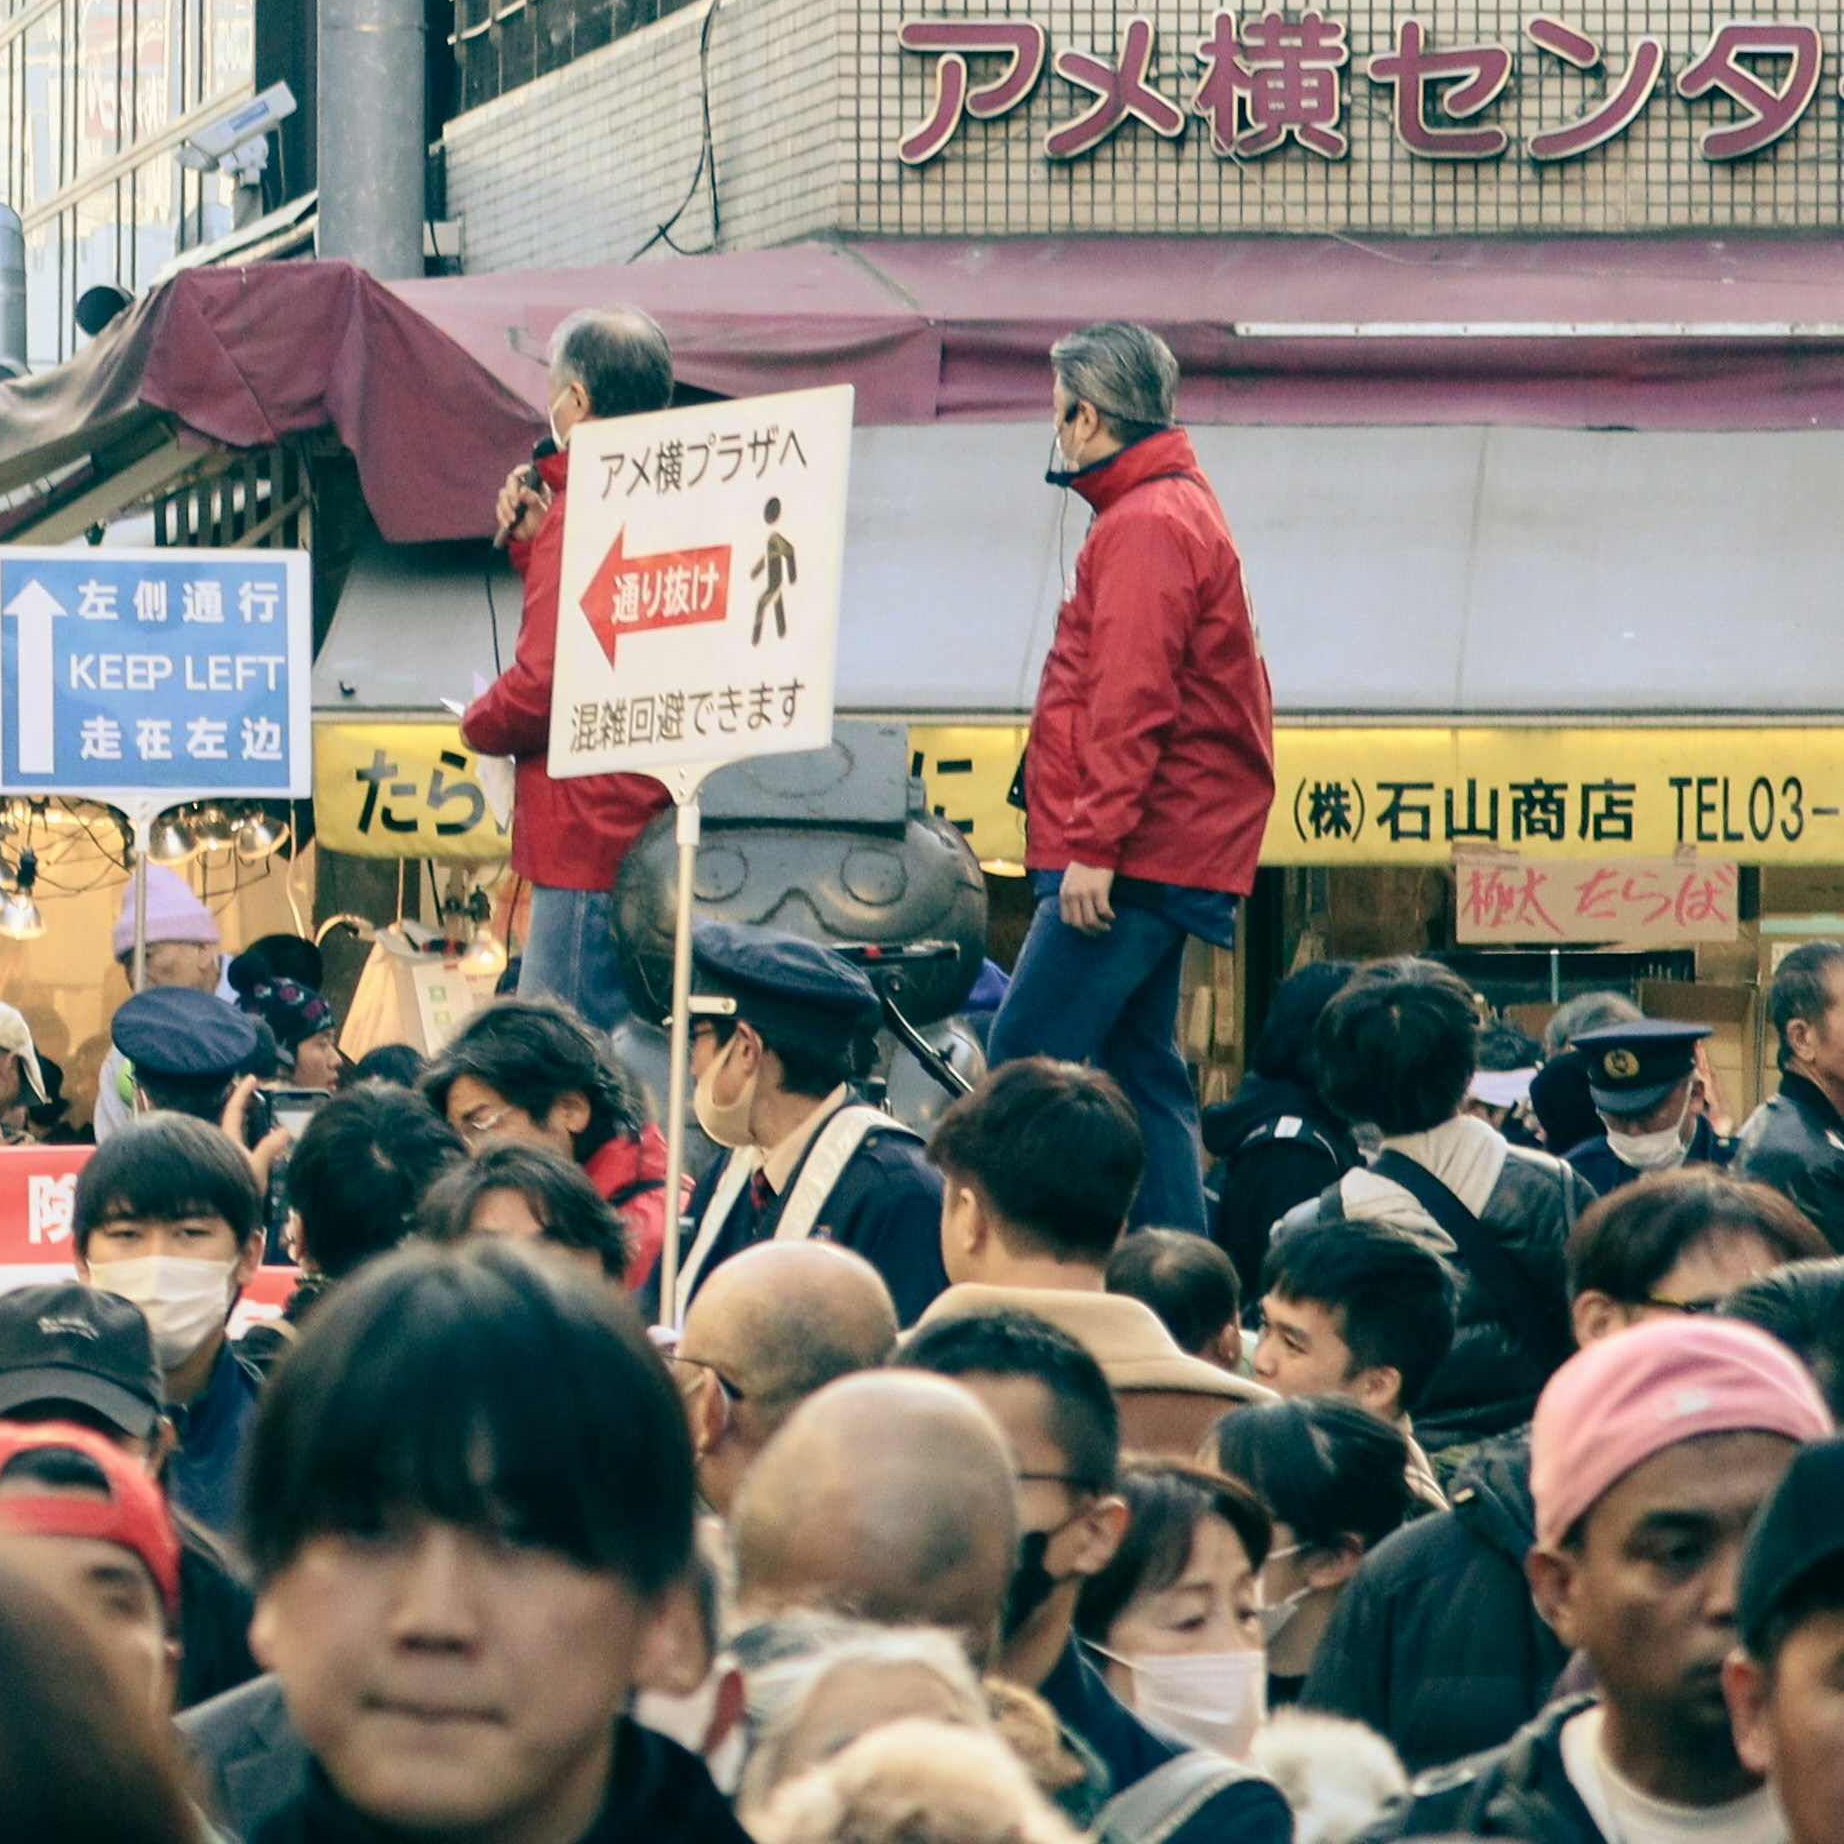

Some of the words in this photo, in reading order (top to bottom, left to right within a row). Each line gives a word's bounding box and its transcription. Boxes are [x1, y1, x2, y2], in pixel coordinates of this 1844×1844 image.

[898, 8, 1844, 165] アメ横センタ
[600, 424, 807, 500] アメ横プラザへ
[78, 579, 280, 623] 左側通行
[611, 563, 720, 624] 通り抜け
[70, 654, 173, 690] KEEP
[185, 655, 285, 690] LEFT
[81, 715, 283, 761] 走在左边
[571, 678, 805, 753] 混雑回避できます
[356, 749, 512, 836] たら
